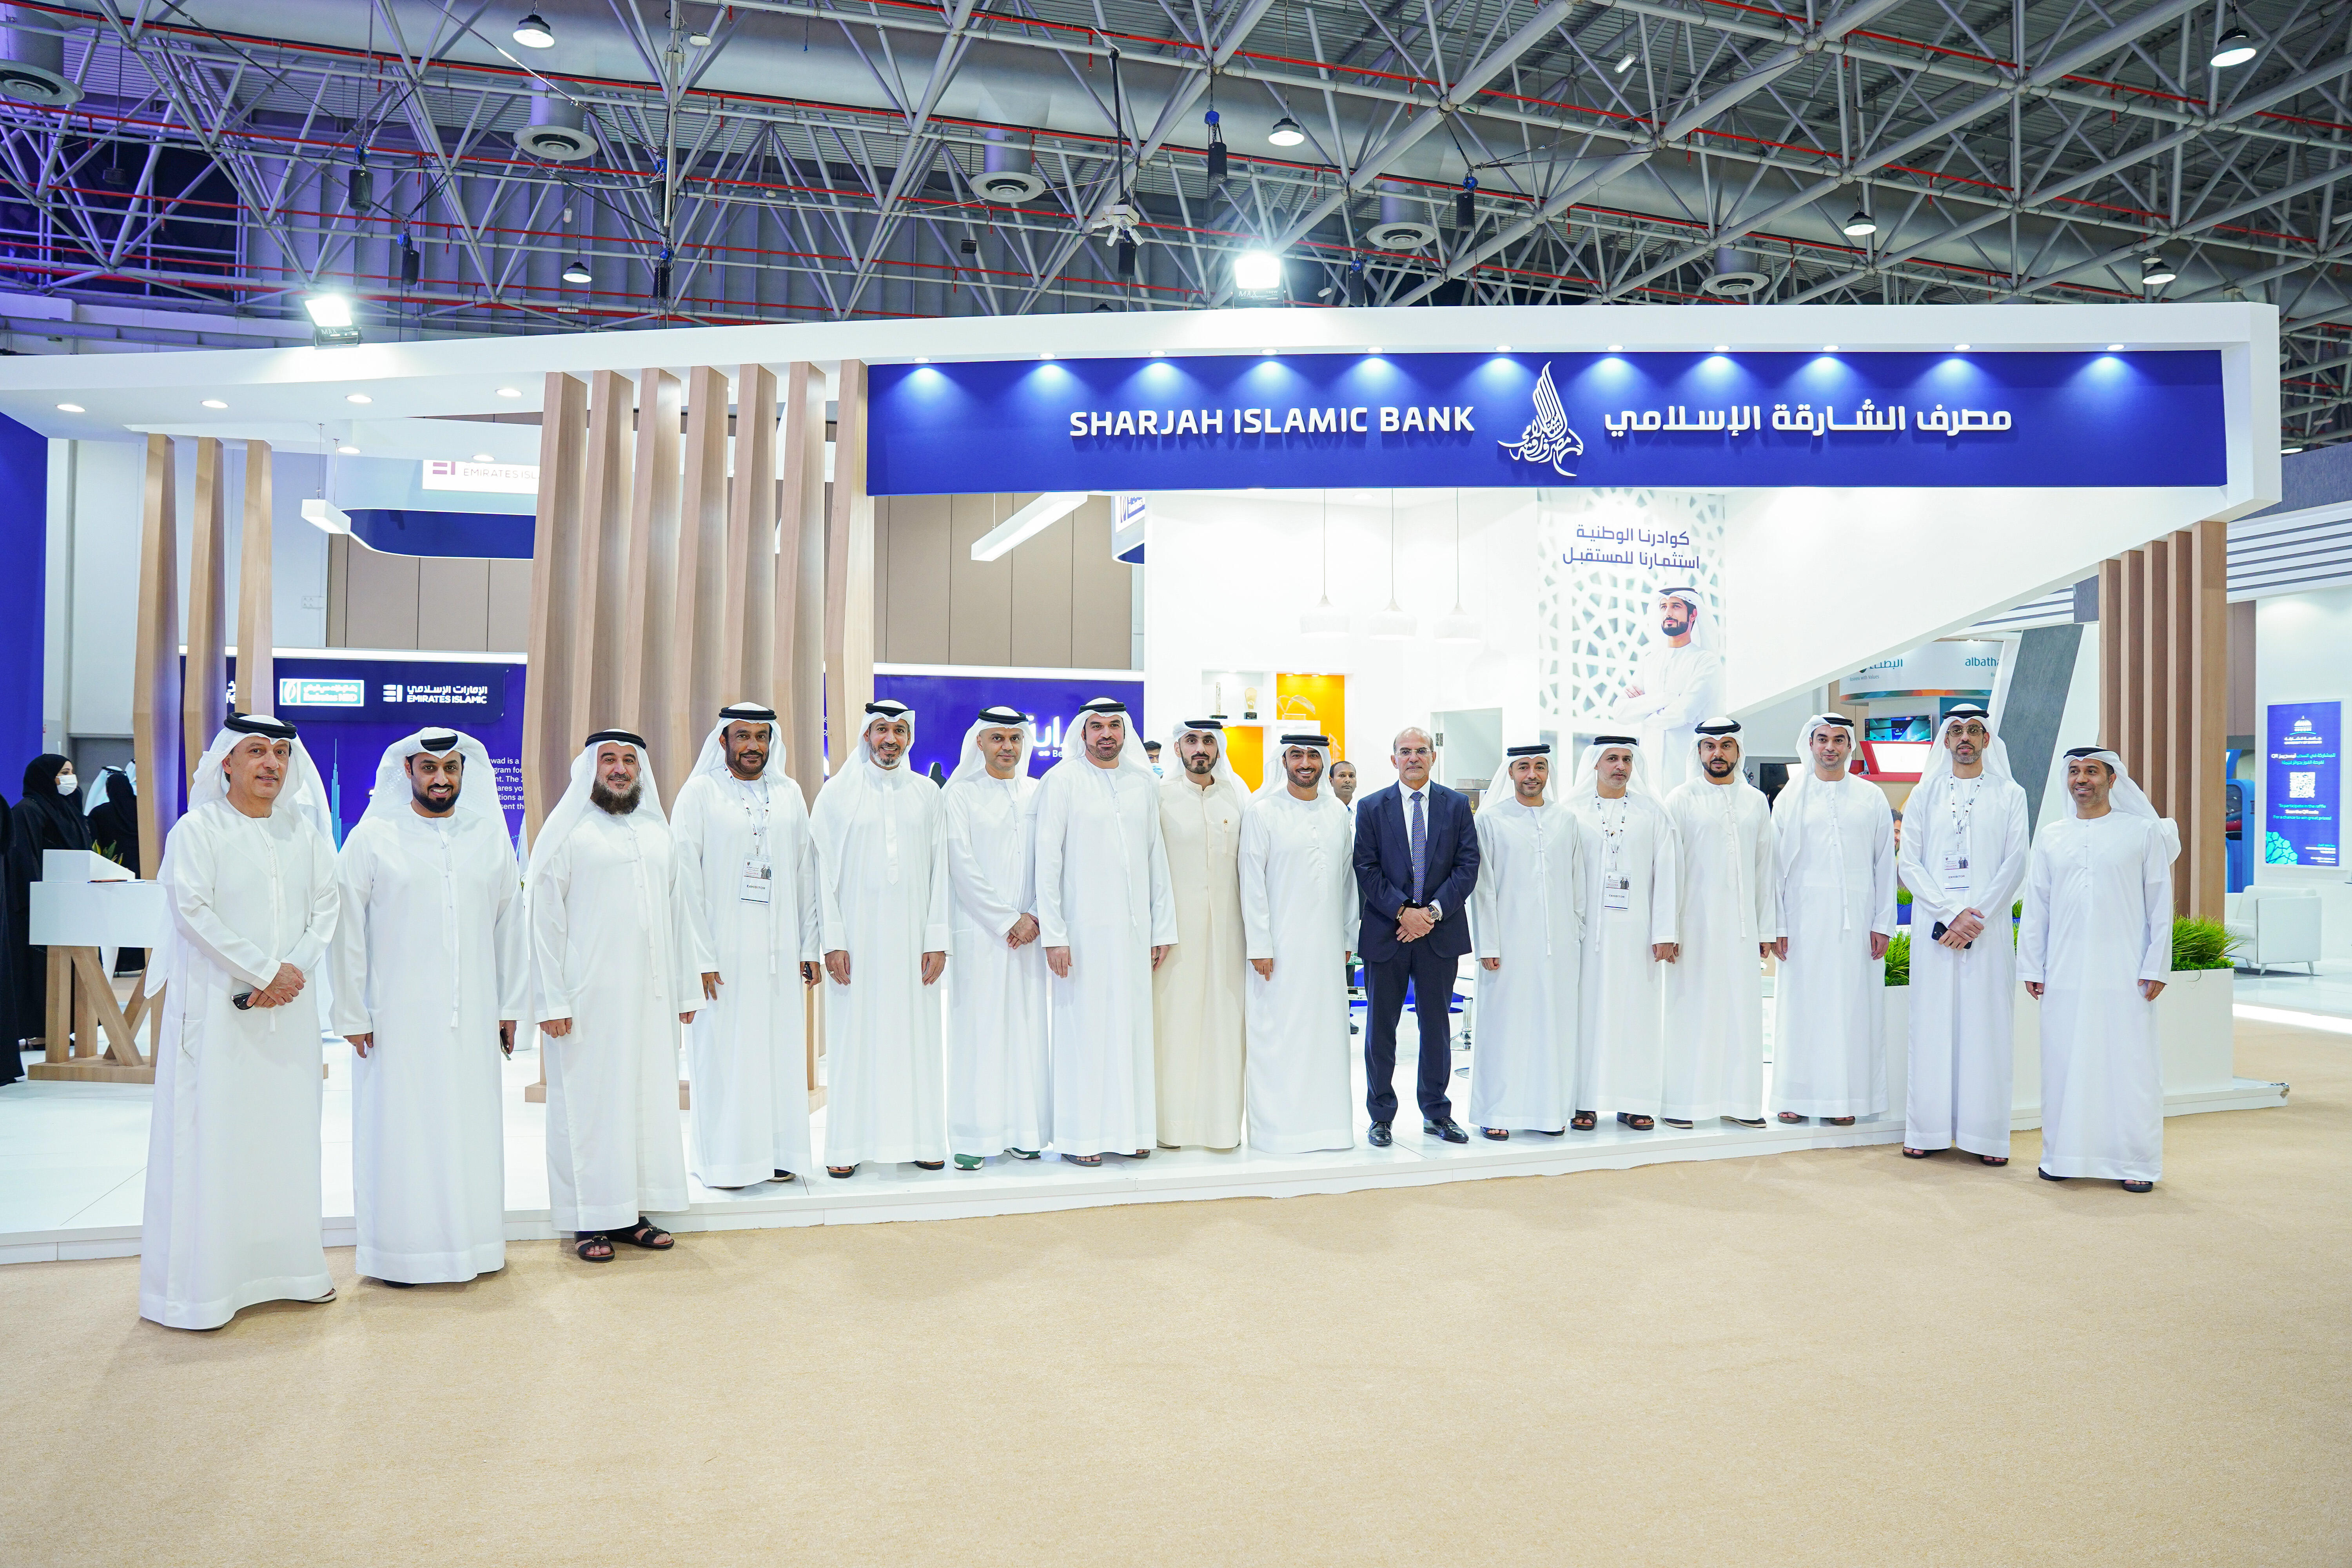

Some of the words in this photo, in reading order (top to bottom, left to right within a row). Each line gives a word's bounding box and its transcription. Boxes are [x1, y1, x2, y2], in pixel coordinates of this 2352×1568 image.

[1070, 409, 1222, 436] SHARJAH
[1234, 407, 1367, 434] ISLAMIC
[1380, 406, 1475, 432] BANK
[1605, 406, 1760, 437] الإسلامي
[1772, 399, 1906, 436] الشارقة
[1917, 404, 2011, 436] مصرف
[464, 468, 518, 478] EMIRATES
[522, 471, 539, 479] ISL
[1576, 524, 1633, 544] الوطنية
[1639, 528, 1689, 548] كوادرنا
[1563, 547, 1633, 564] للمستقبل
[1639, 552, 1699, 570] استثمارنا
[407, 685, 451, 695] الإسلامي
[407, 695, 451, 703] EMIRATES
[452, 695, 487, 704] ISLAMIC
[453, 686, 488, 695] الإمارات
